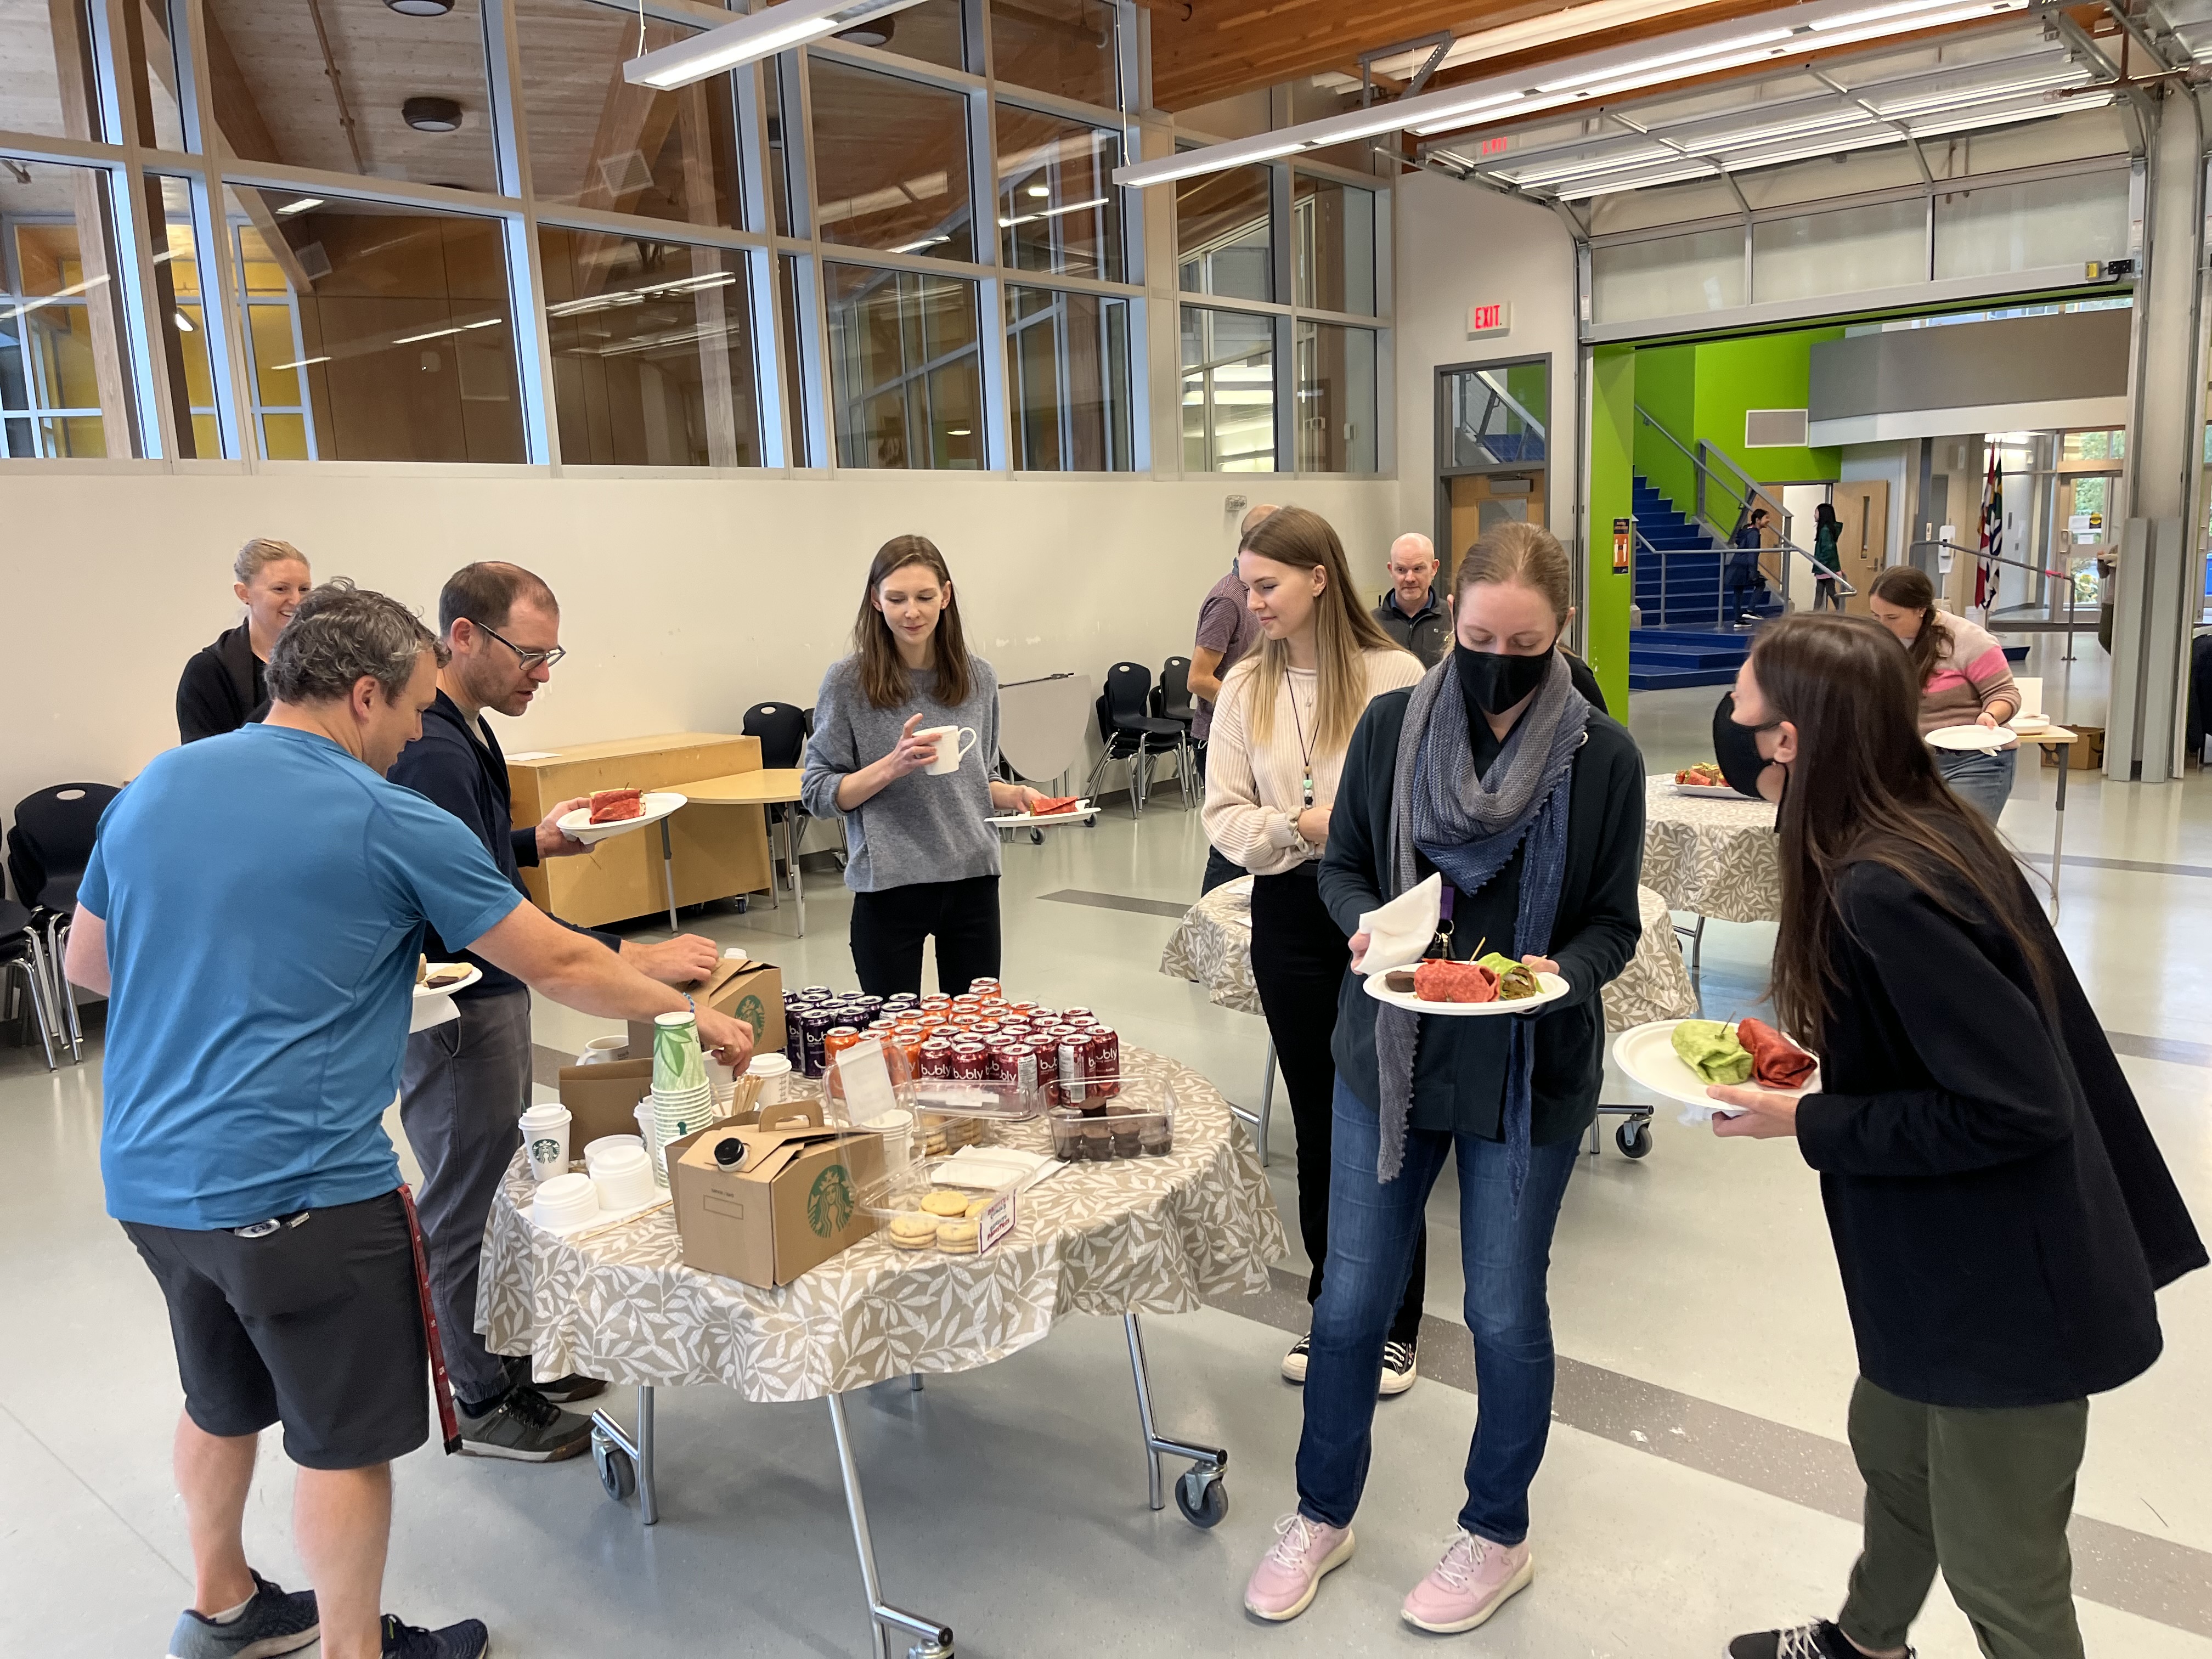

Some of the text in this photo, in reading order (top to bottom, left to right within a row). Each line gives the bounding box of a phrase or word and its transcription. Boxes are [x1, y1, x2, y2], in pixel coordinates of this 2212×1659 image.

[1475, 304, 1500, 329] EXIT
[921, 1063, 951, 1077] bubly
[953, 1067, 984, 1080] bubly
